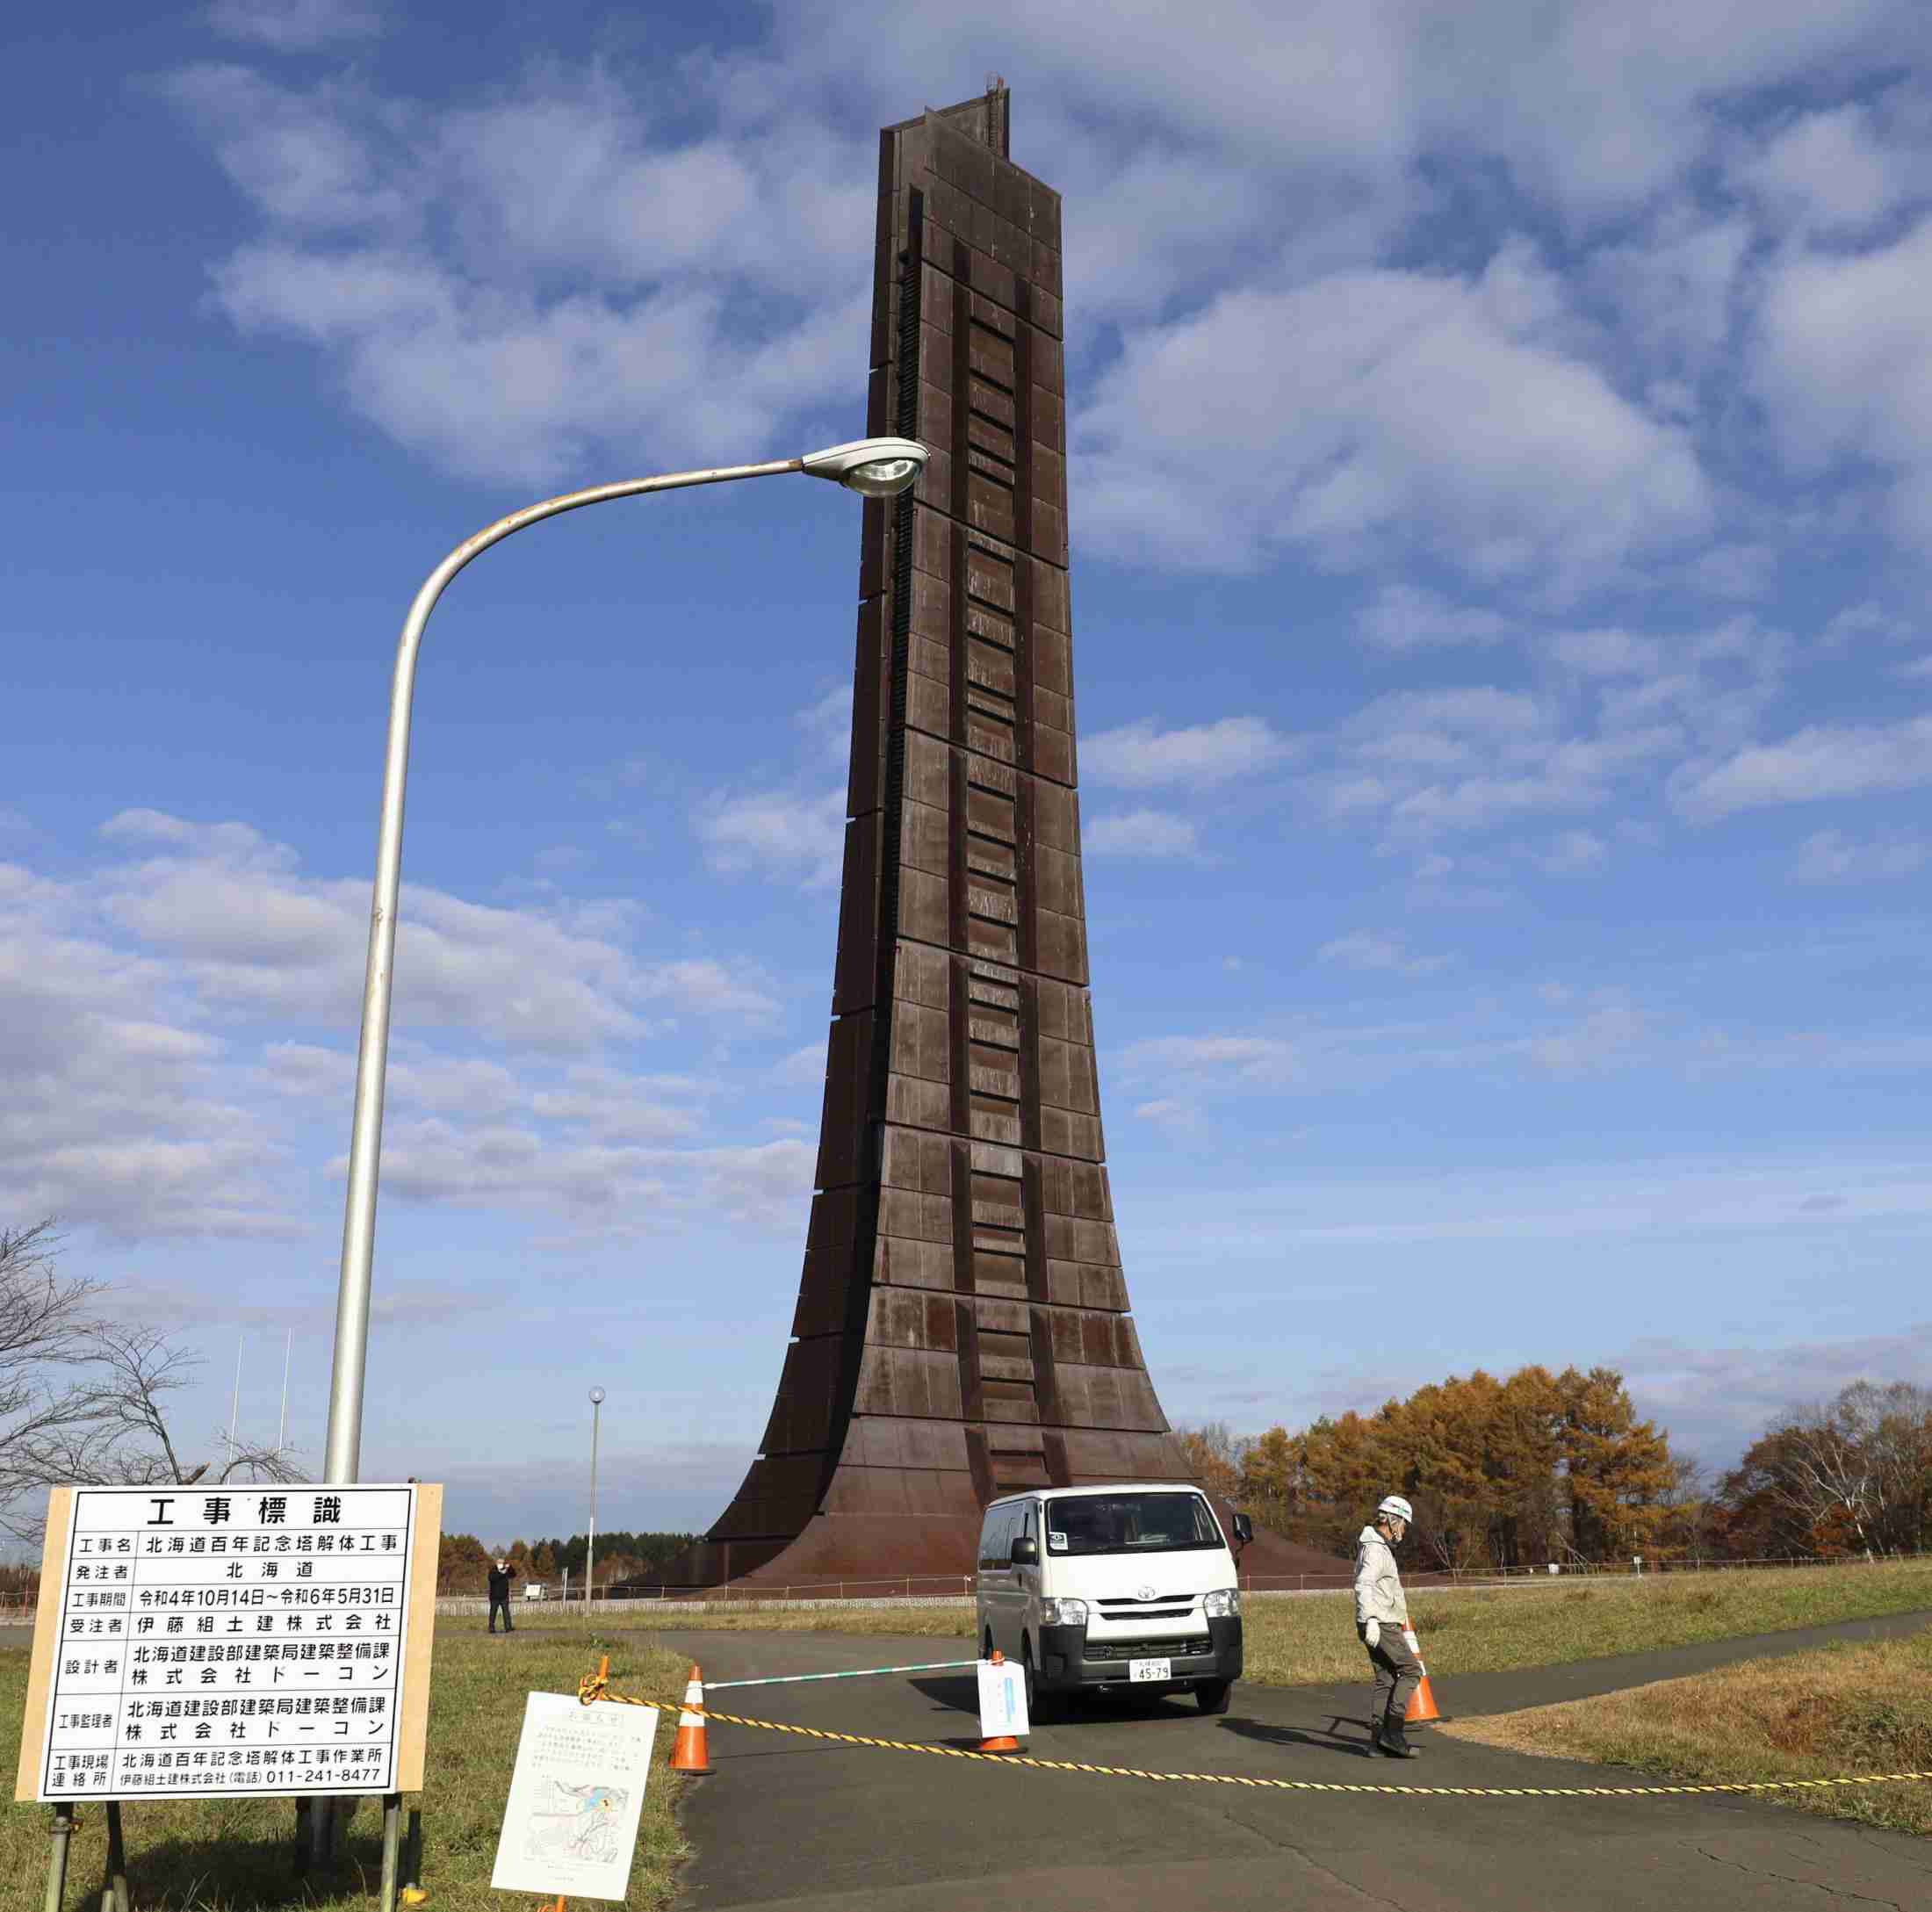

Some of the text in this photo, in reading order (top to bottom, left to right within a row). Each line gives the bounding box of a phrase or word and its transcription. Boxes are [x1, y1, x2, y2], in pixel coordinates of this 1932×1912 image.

[148, 1497, 341, 1525] 工事標識
[79, 1538, 131, 1553] 工事名
[146, 1534, 398, 1553] 北海道百年記念塔解体工事
[76, 1565, 128, 1580] 発注者
[227, 1562, 313, 1578] 北海道
[72, 1592, 126, 1607] 工事期間
[70, 1619, 122, 1633] 受注者
[137, 1613, 391, 1634] 伊藤組土建株式会社
[133, 1642, 390, 1663] 北海道建設部建築局建築整備課
[65, 1659, 119, 1674] 設計者
[1139, 1667, 1169, 1679] 45-79
[132, 1665, 388, 1685] 株式会社ドーコン
[127, 1697, 386, 1718] 北海道建設部建築局建築整備課
[58, 1714, 112, 1728] 工事監理者
[126, 1720, 384, 1741] 株式会社ドーコン
[54, 1754, 109, 1771] 工事現場
[122, 1748, 382, 1768] 北海道百年記念塔解体工事作業所
[52, 1771, 106, 1787] 連絡所
[267, 1768, 380, 1784] 011-241-8477
